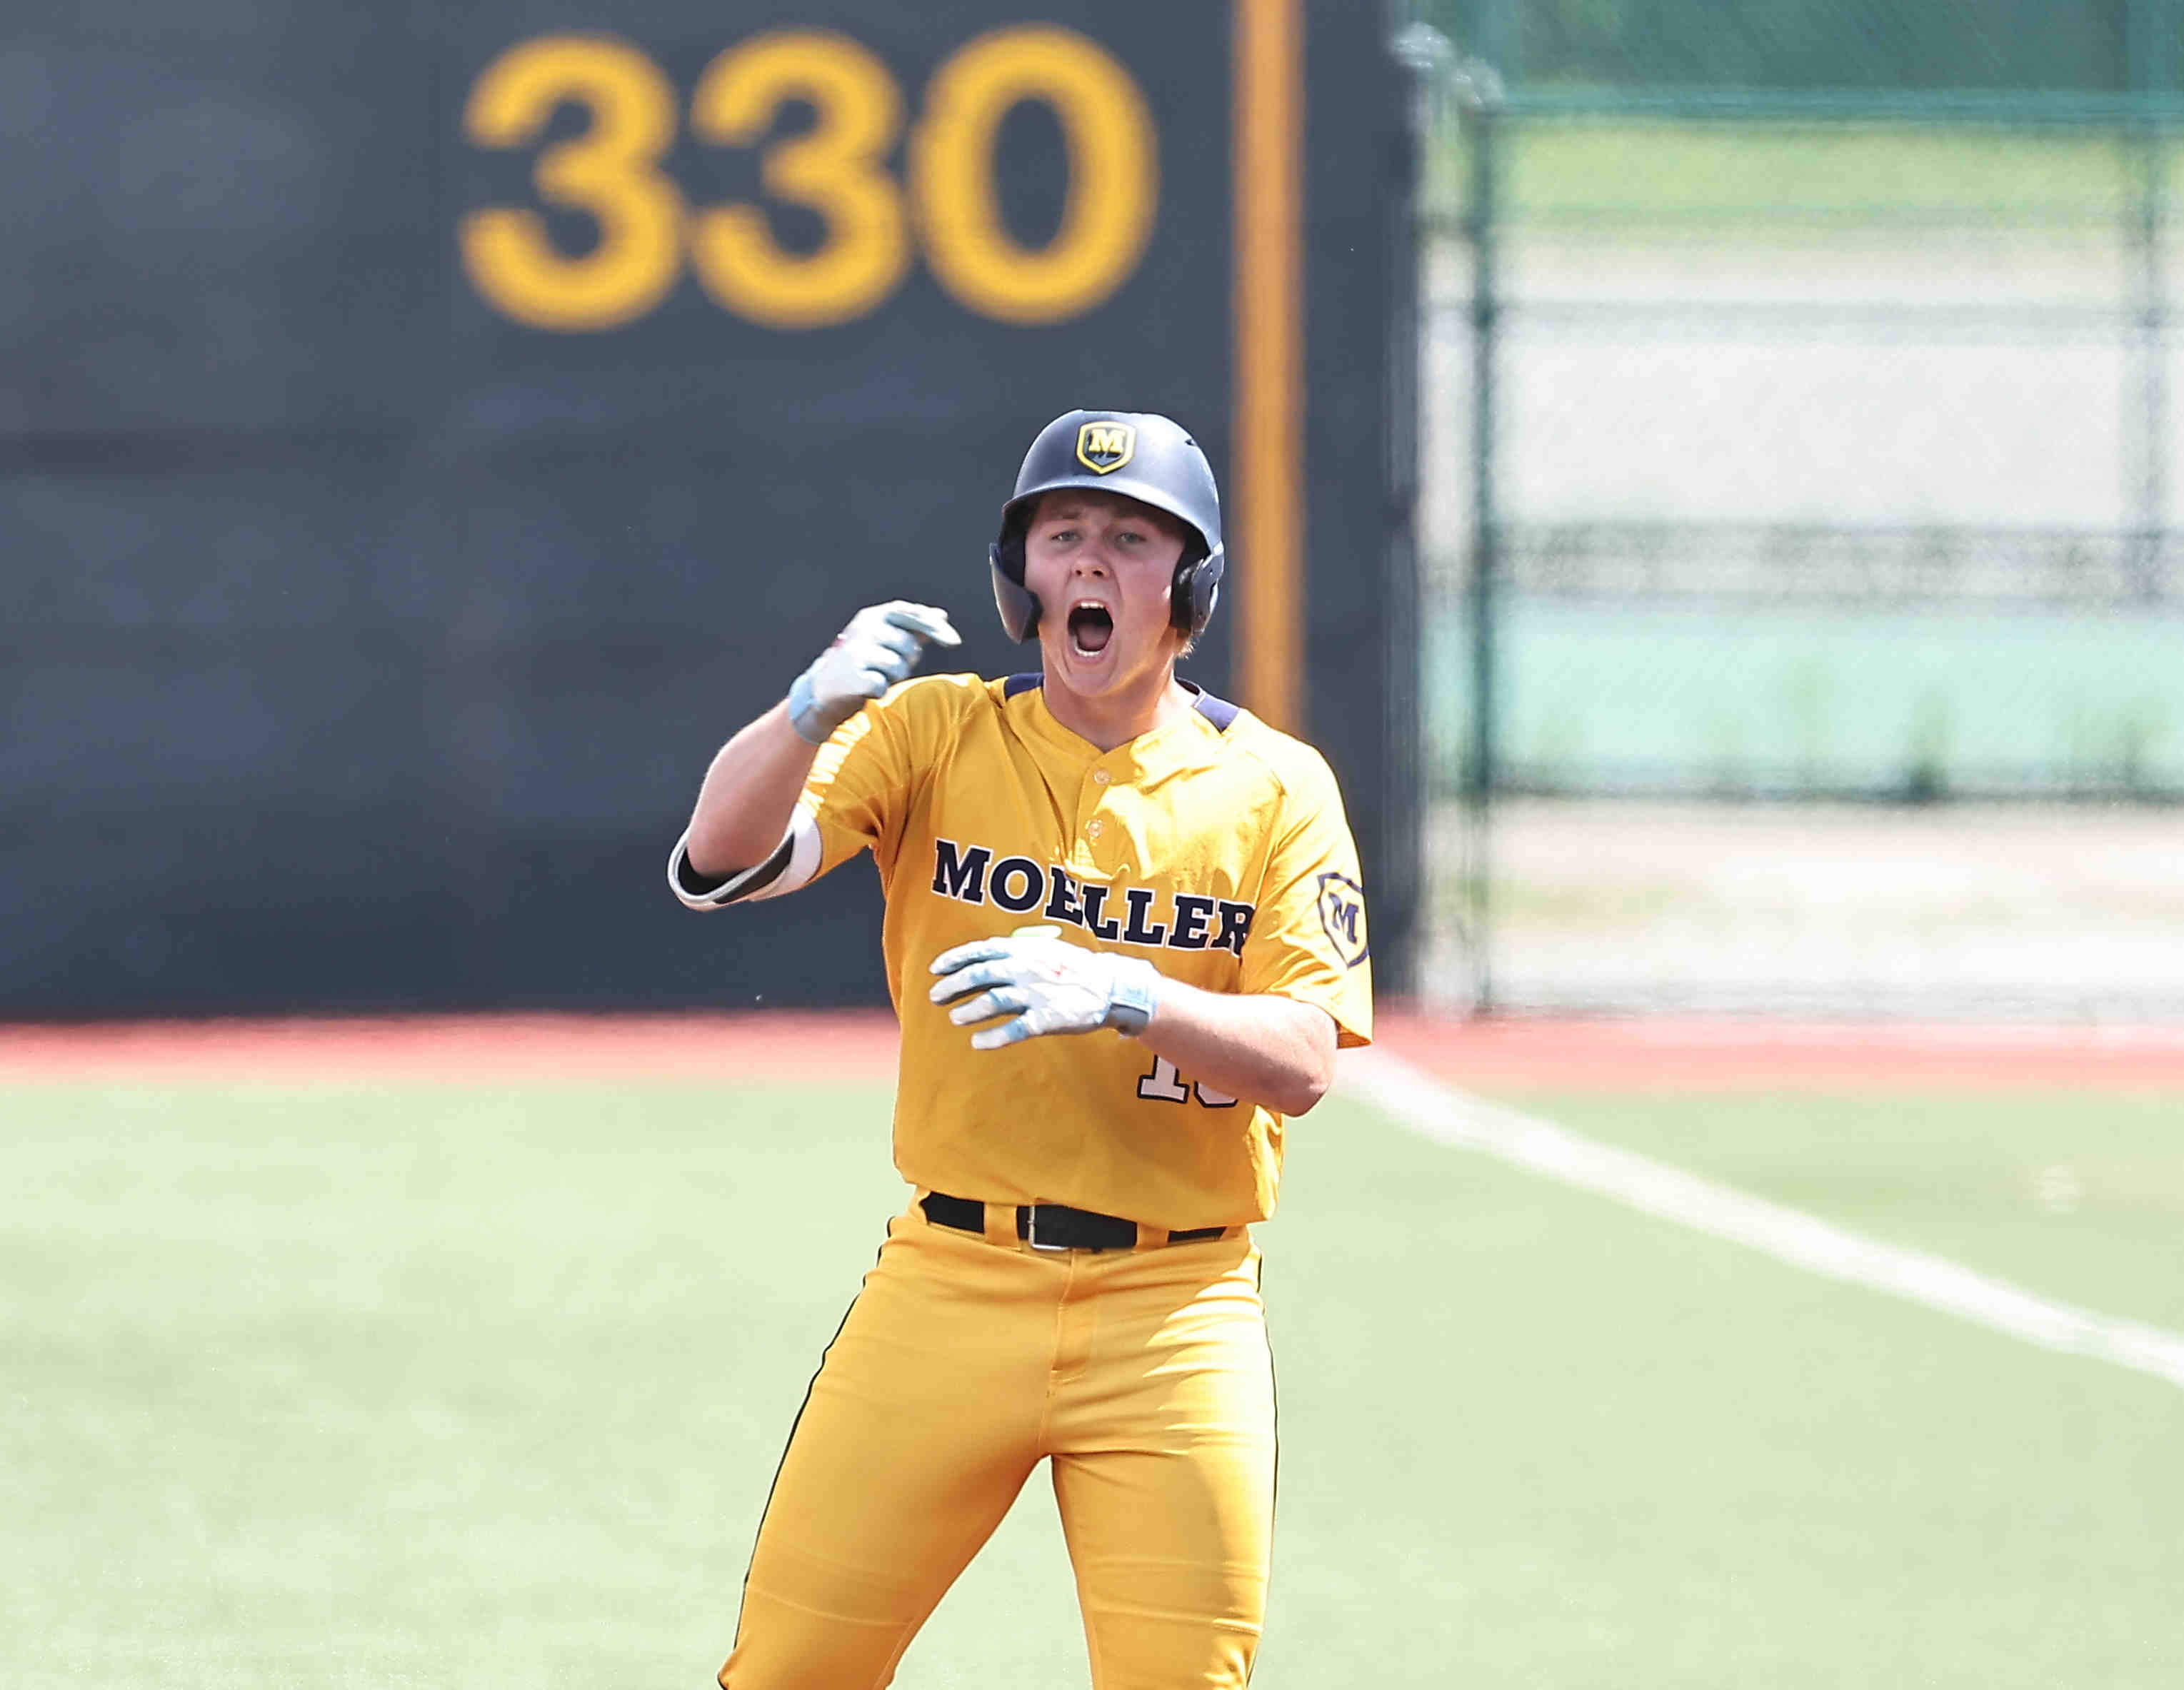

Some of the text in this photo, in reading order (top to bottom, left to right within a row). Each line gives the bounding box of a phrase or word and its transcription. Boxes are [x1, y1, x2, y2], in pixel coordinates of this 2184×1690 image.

[460, 24, 1157, 331] 330
[1088, 428, 1126, 453] M
[931, 838, 1256, 957] MOELLER
[1328, 891, 1359, 944] M
